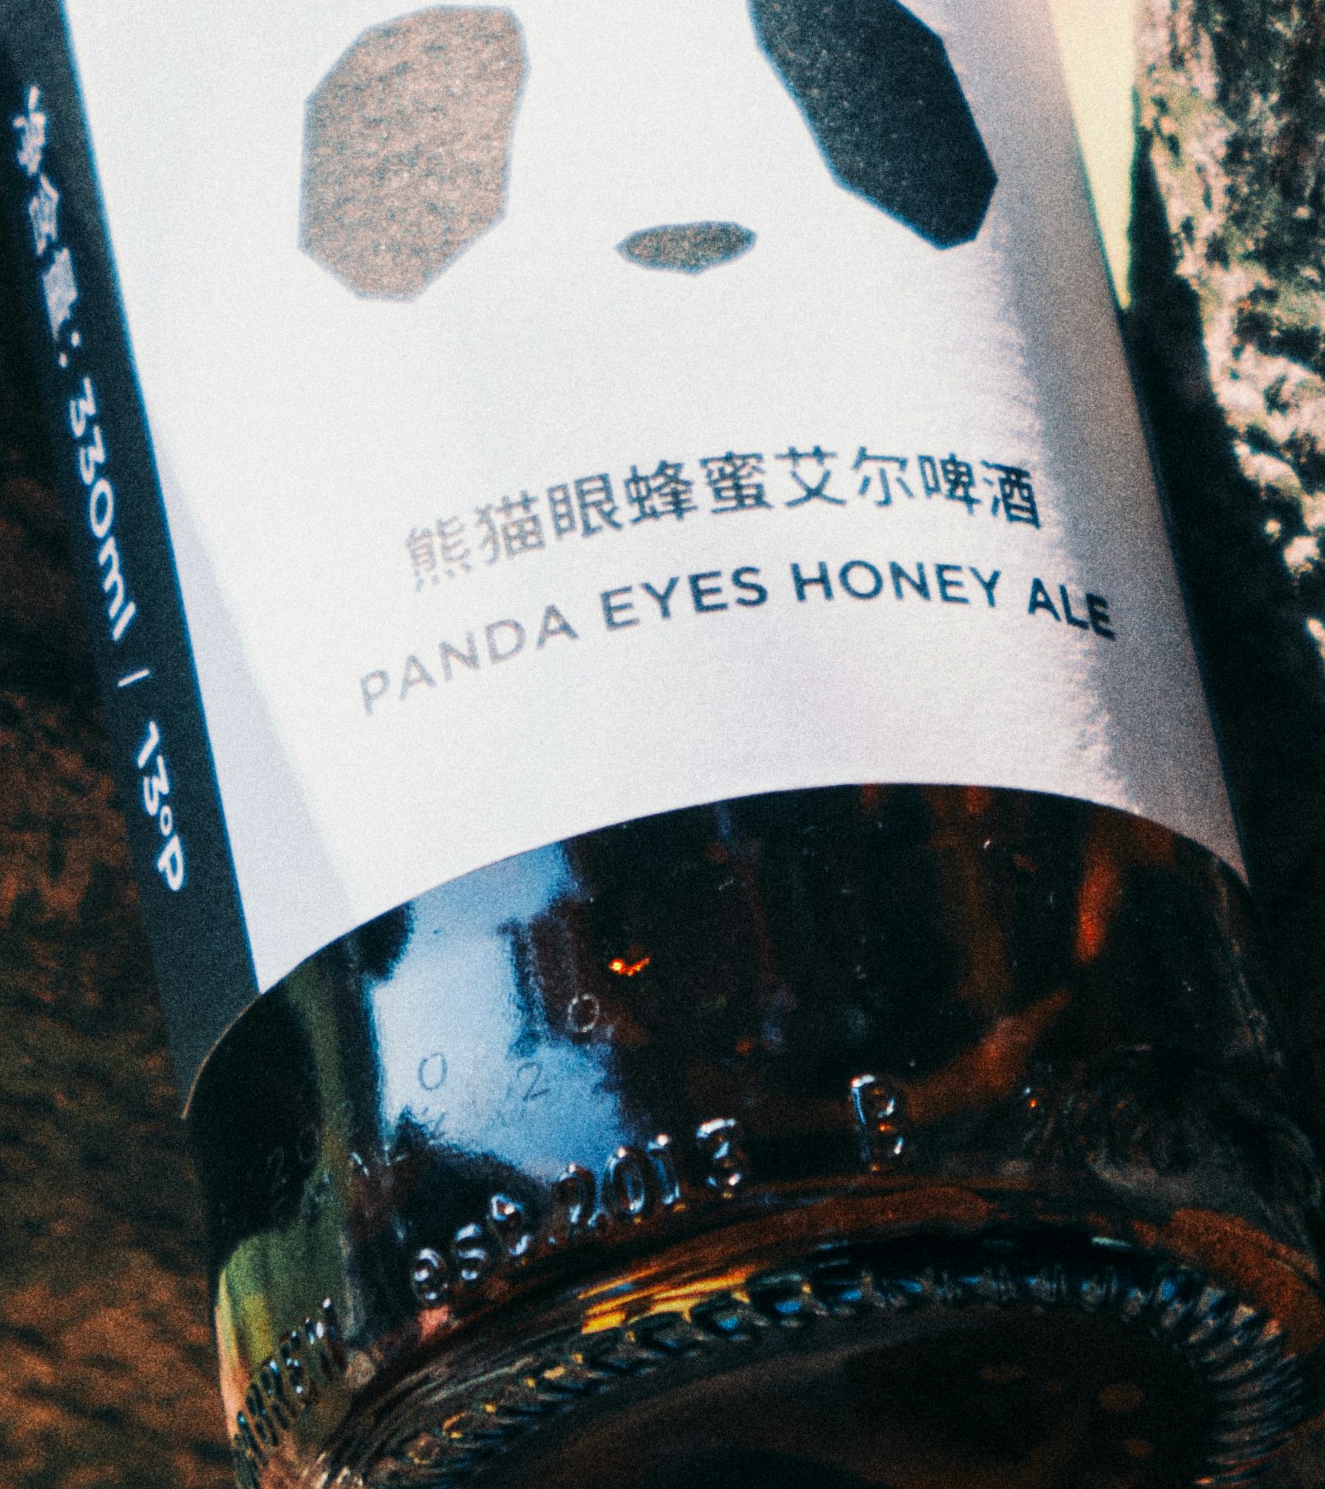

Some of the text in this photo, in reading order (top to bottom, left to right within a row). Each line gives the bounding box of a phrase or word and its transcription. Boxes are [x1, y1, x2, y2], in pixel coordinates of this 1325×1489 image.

[403, 446, 1043, 591] 熊猫眼蜂蜜艾尔啤酒
[357, 559, 1118, 716] PANDA EYES HONEY ALE
